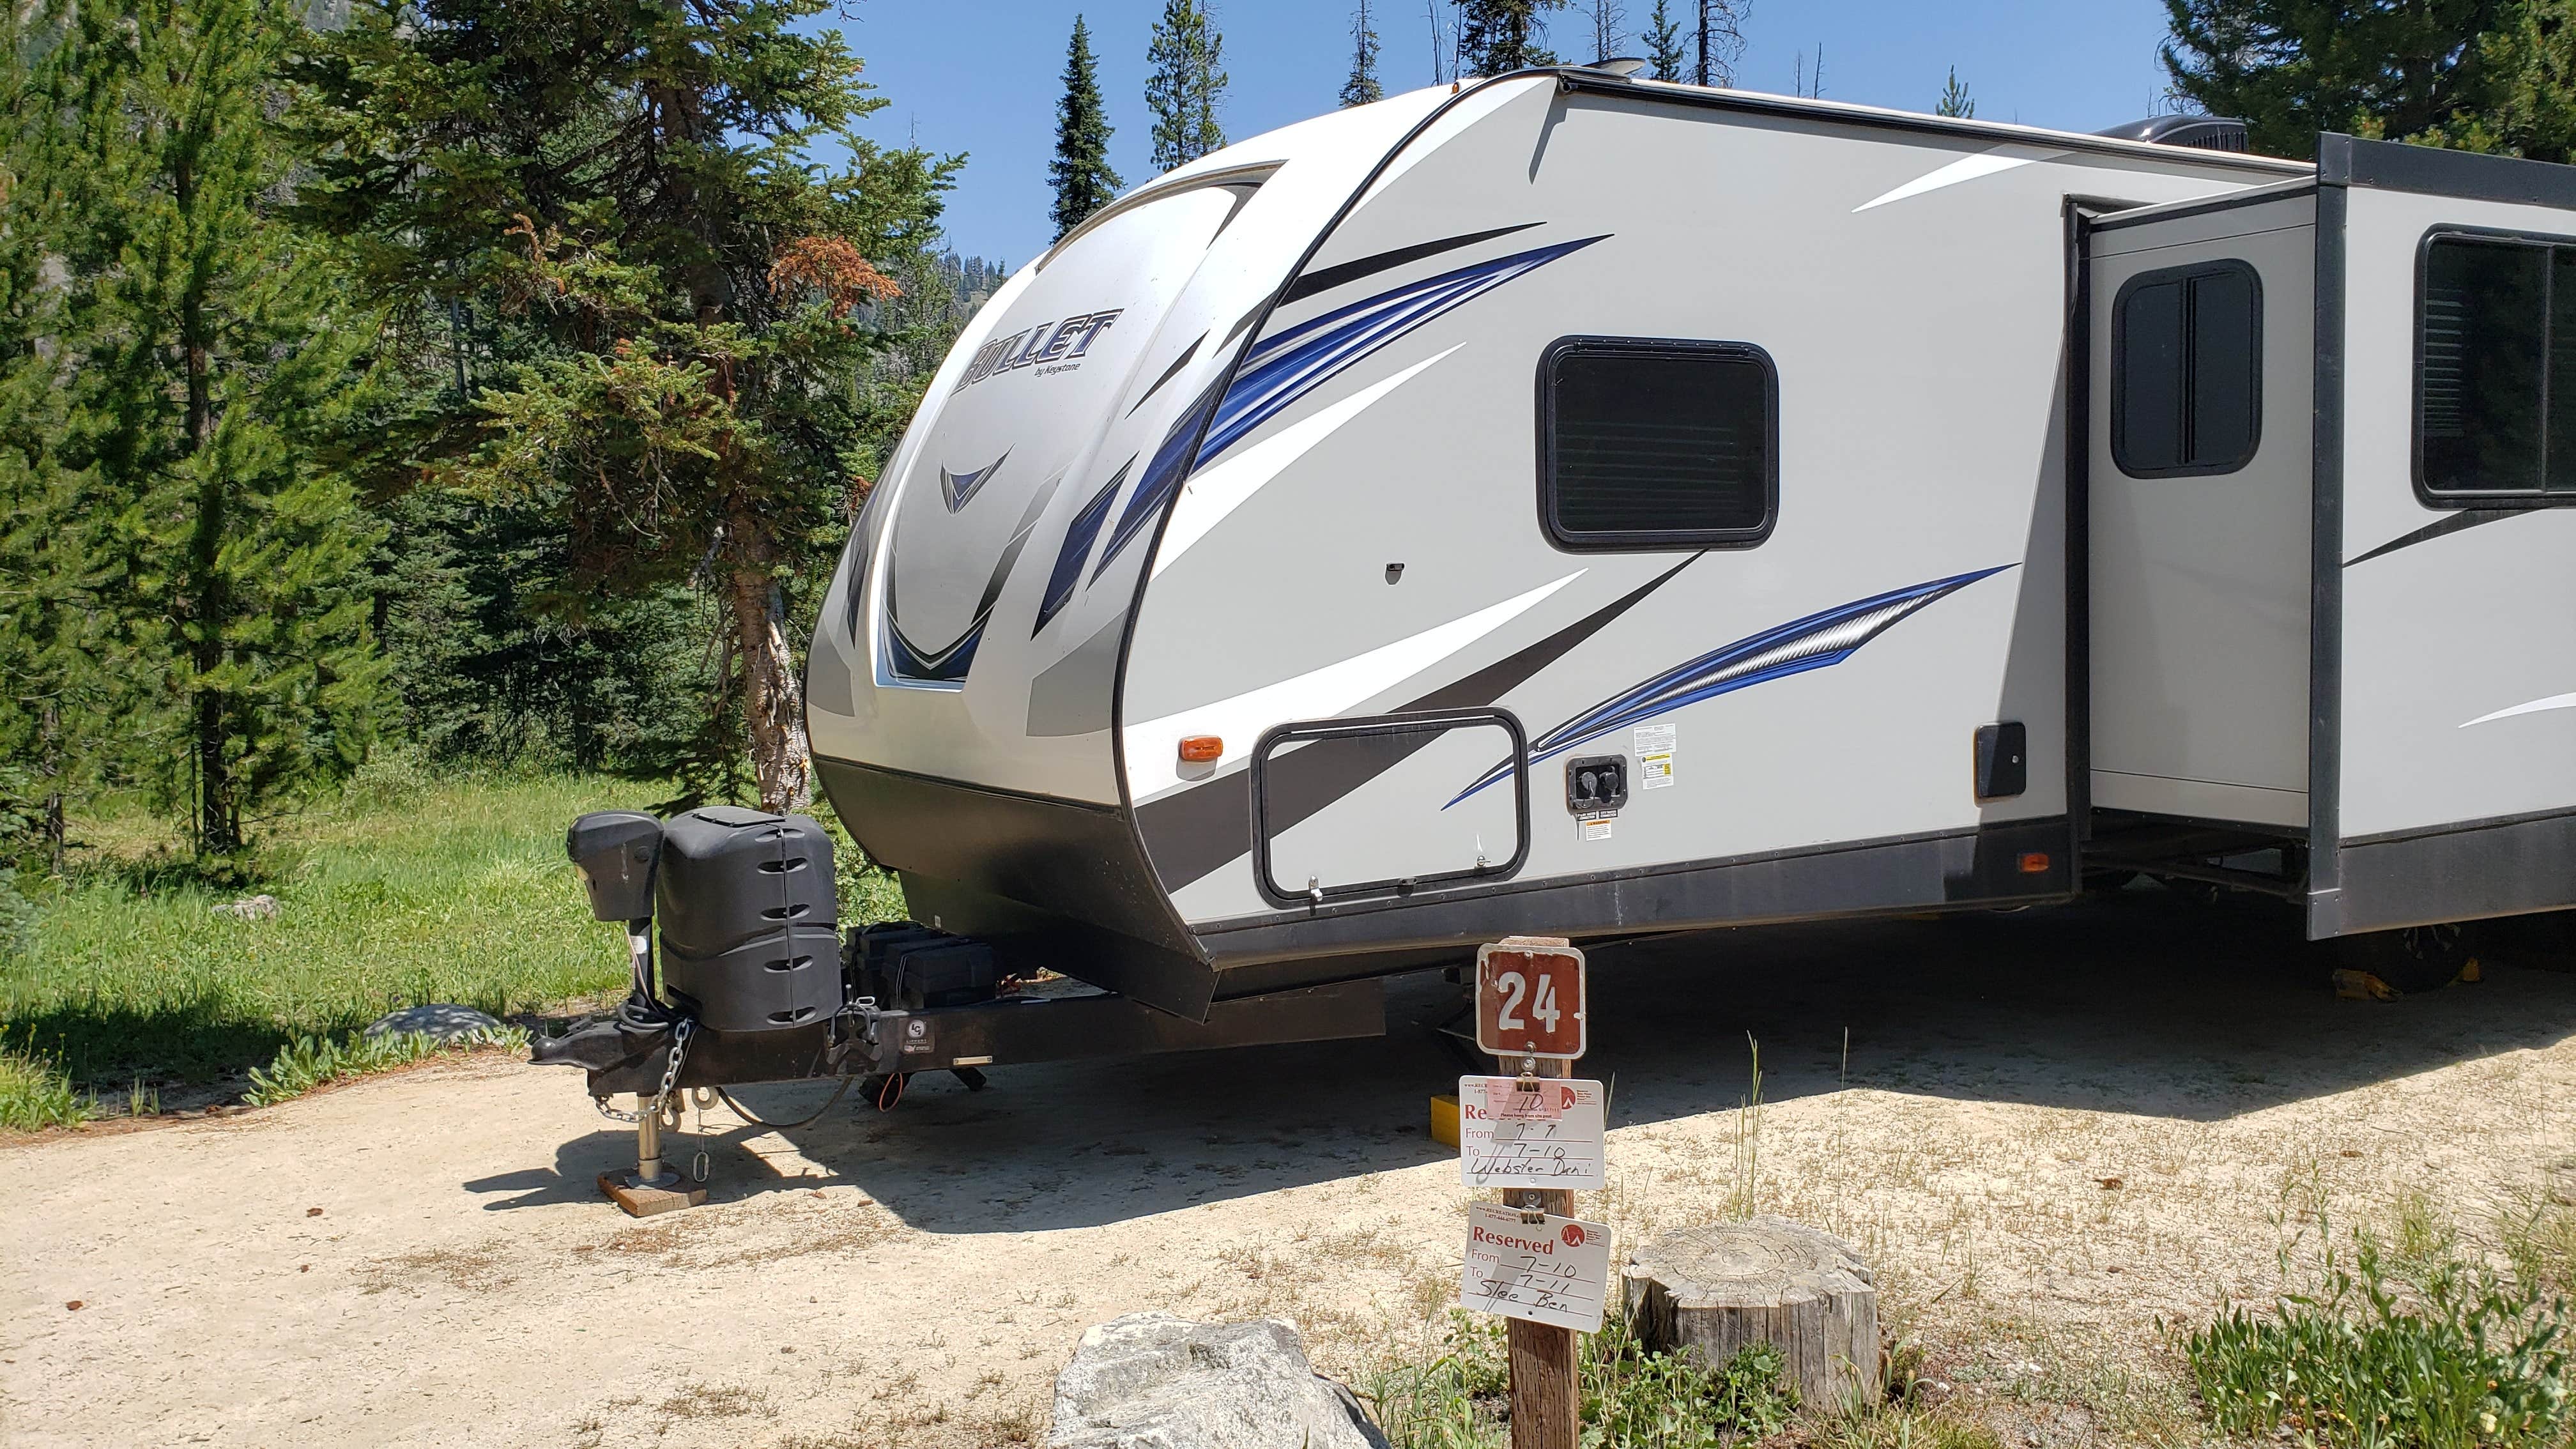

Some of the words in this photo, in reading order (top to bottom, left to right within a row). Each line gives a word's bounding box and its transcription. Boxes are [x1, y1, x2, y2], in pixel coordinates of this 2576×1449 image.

[1034, 367, 1045, 378] by
[1045, 364, 1080, 375] Keystone
[1498, 971, 1561, 1033] 24
[1519, 1093, 1544, 1113] 10
[1466, 1128, 1494, 1138] From
[1466, 1146, 1480, 1157] To
[1471, 1158, 1544, 1174] Webster
[1473, 1226, 1554, 1255] Reserved
[1471, 1248, 1499, 1264] From
[1470, 1266, 1483, 1278] To
[1535, 1290, 1568, 1313] Ben
